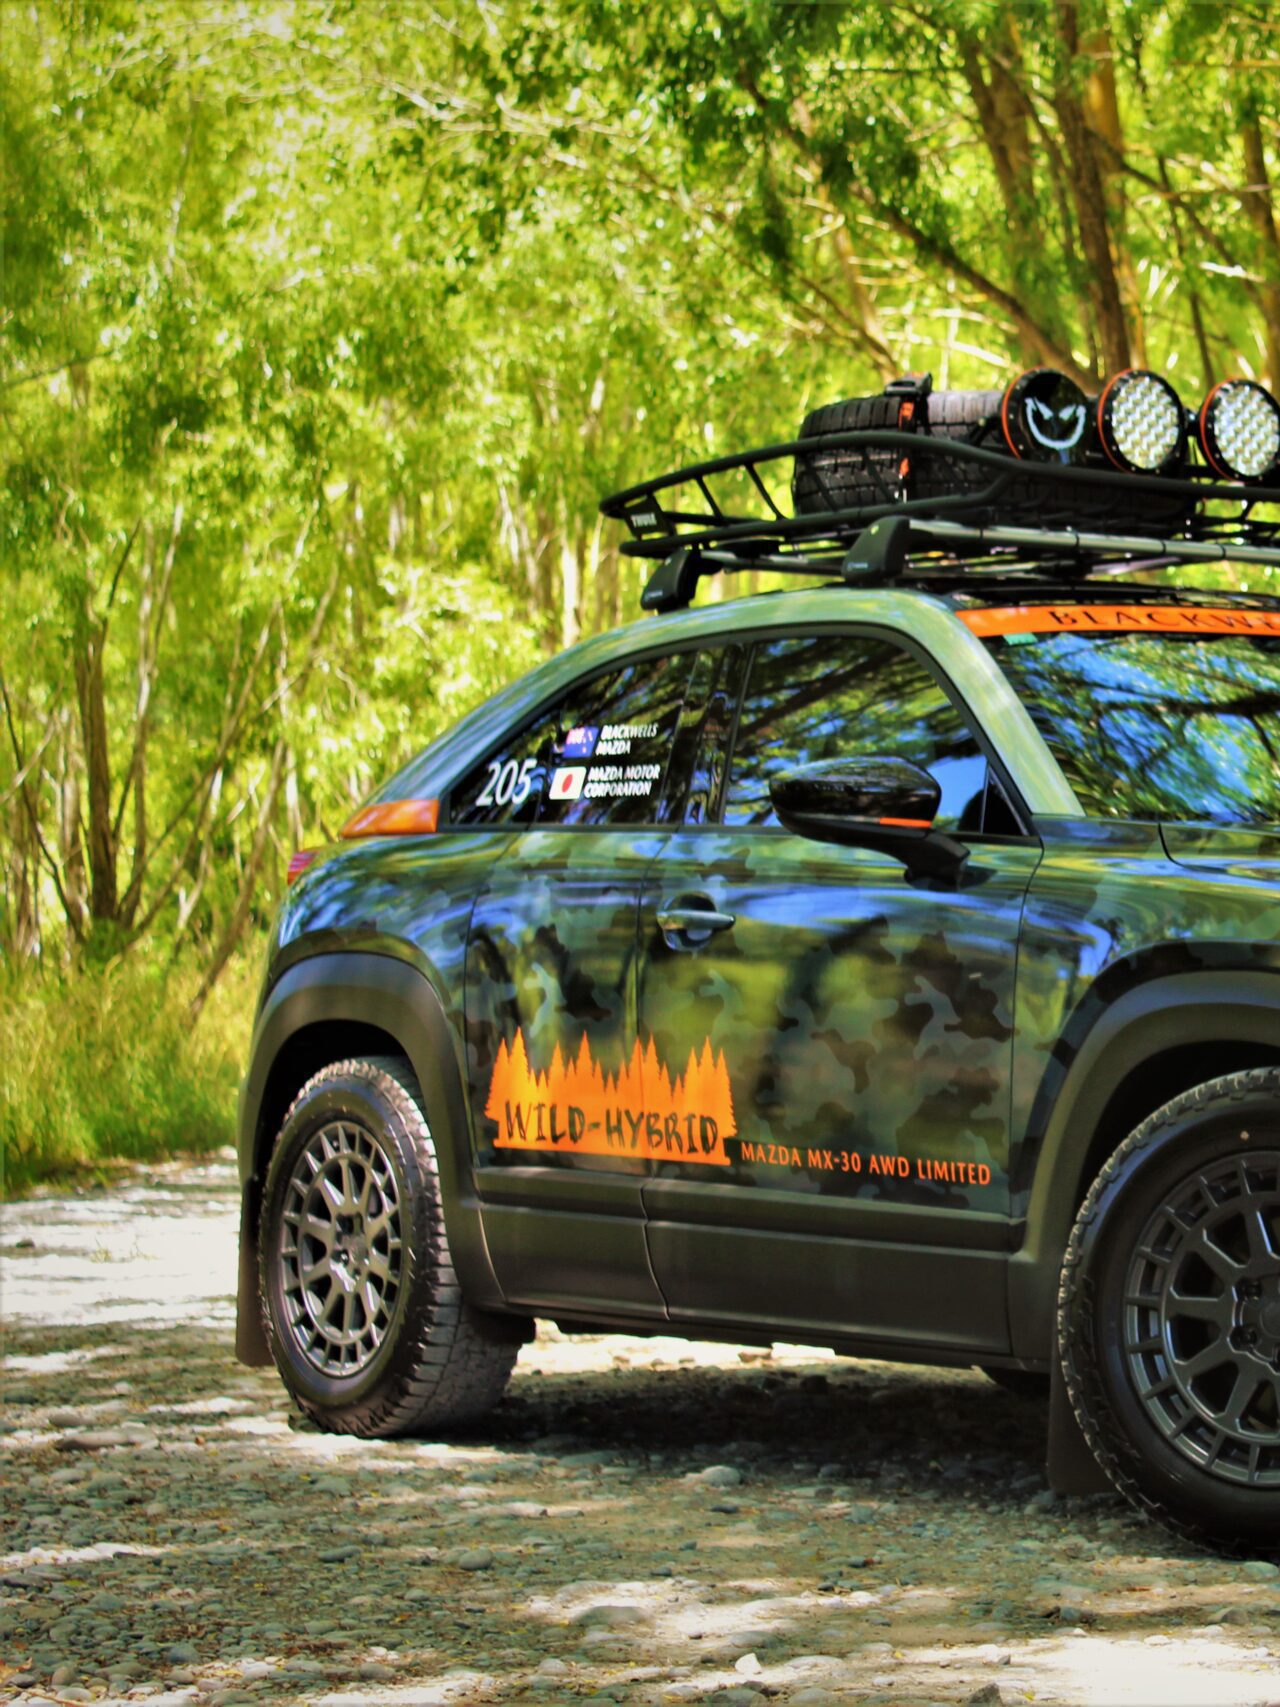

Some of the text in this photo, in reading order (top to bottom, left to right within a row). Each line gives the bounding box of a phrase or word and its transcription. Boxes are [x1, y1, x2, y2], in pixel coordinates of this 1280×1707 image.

[601, 723, 658, 740] BLACKWELLS
[595, 740, 631, 756] MAZDA
[588, 763, 660, 781] MAZDA MOTOR
[475, 758, 537, 807] 205
[583, 780, 652, 798] CORPORATION
[505, 1100, 718, 1153] WILD-HYBRID
[740, 1142, 991, 1185] MAZDA MX-30 AWD LIMITED
